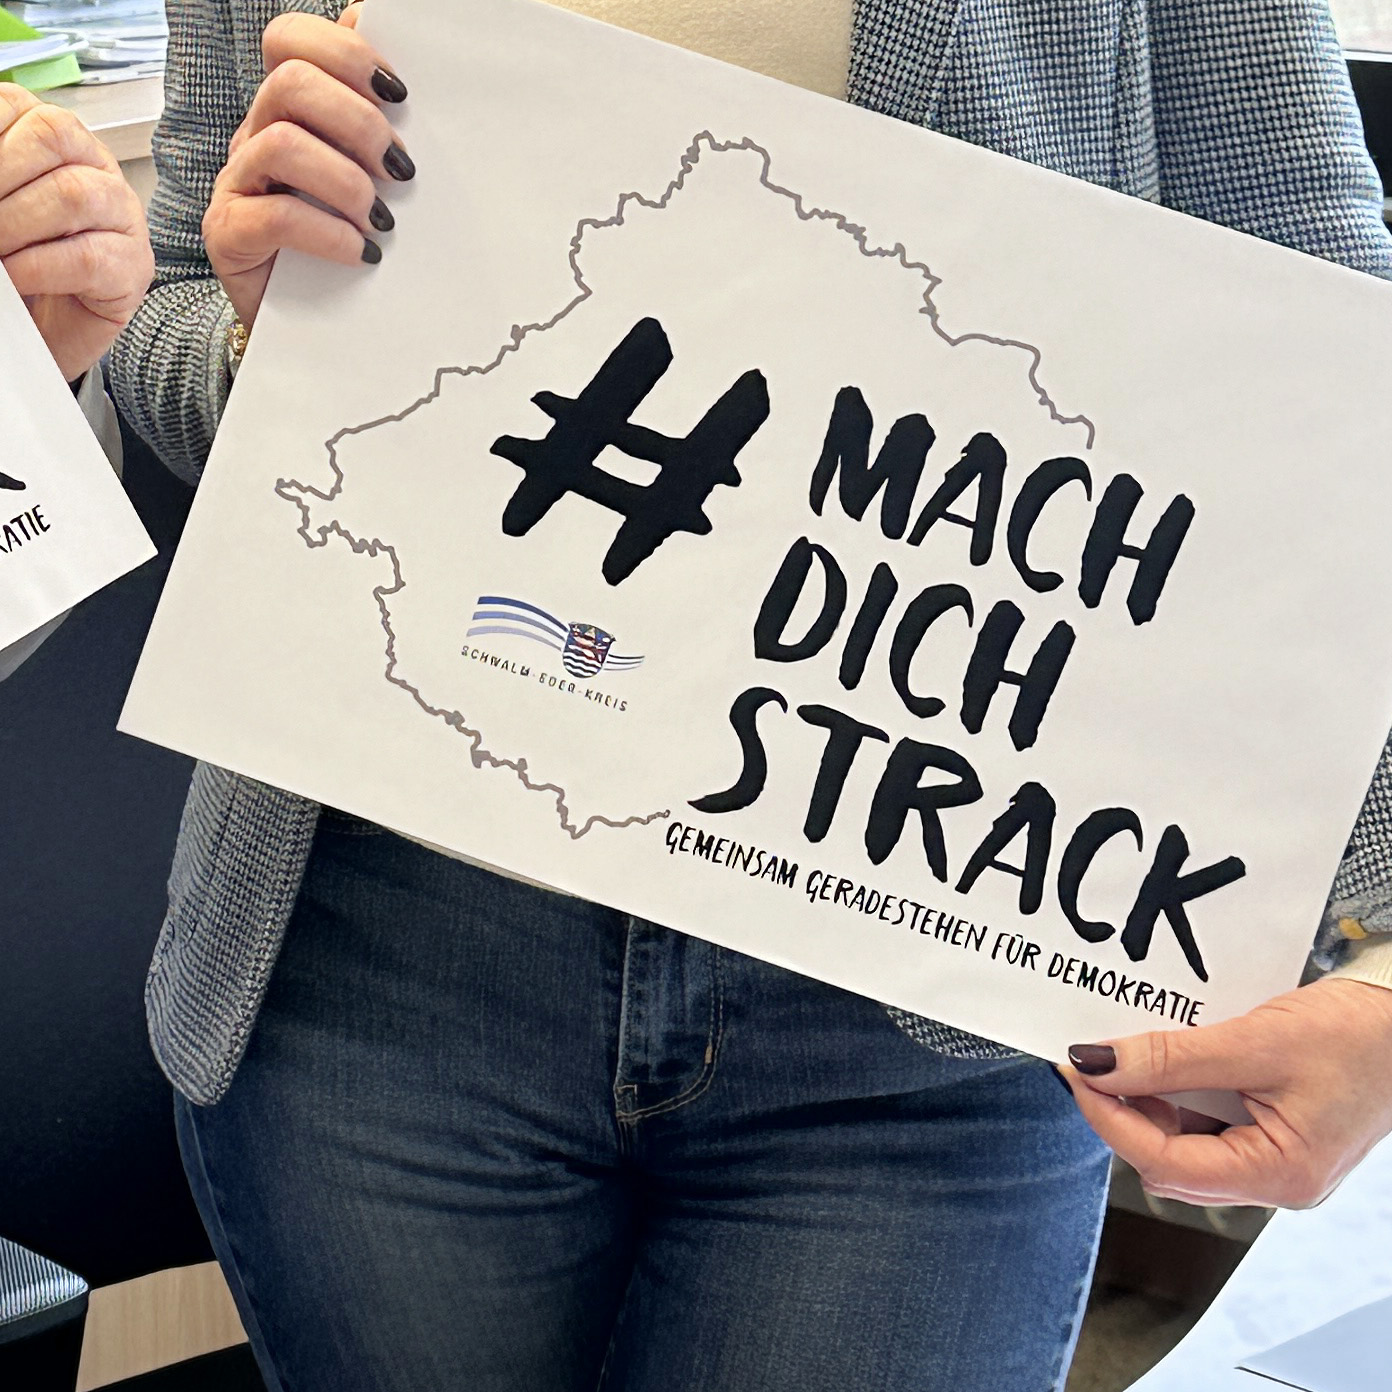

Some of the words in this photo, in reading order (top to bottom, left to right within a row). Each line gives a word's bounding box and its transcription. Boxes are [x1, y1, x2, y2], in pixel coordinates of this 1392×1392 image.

[810, 386, 1195, 625] MACH
[754, 537, 1076, 751] DICH
[666, 822, 798, 888] GEMEINSAM
[806, 870, 987, 951] GERADESTEHEN
[992, 933, 1041, 970] FÜR
[1048, 953, 1205, 1026] DEMOKRATIE
[688, 687, 1245, 982] STRACK
